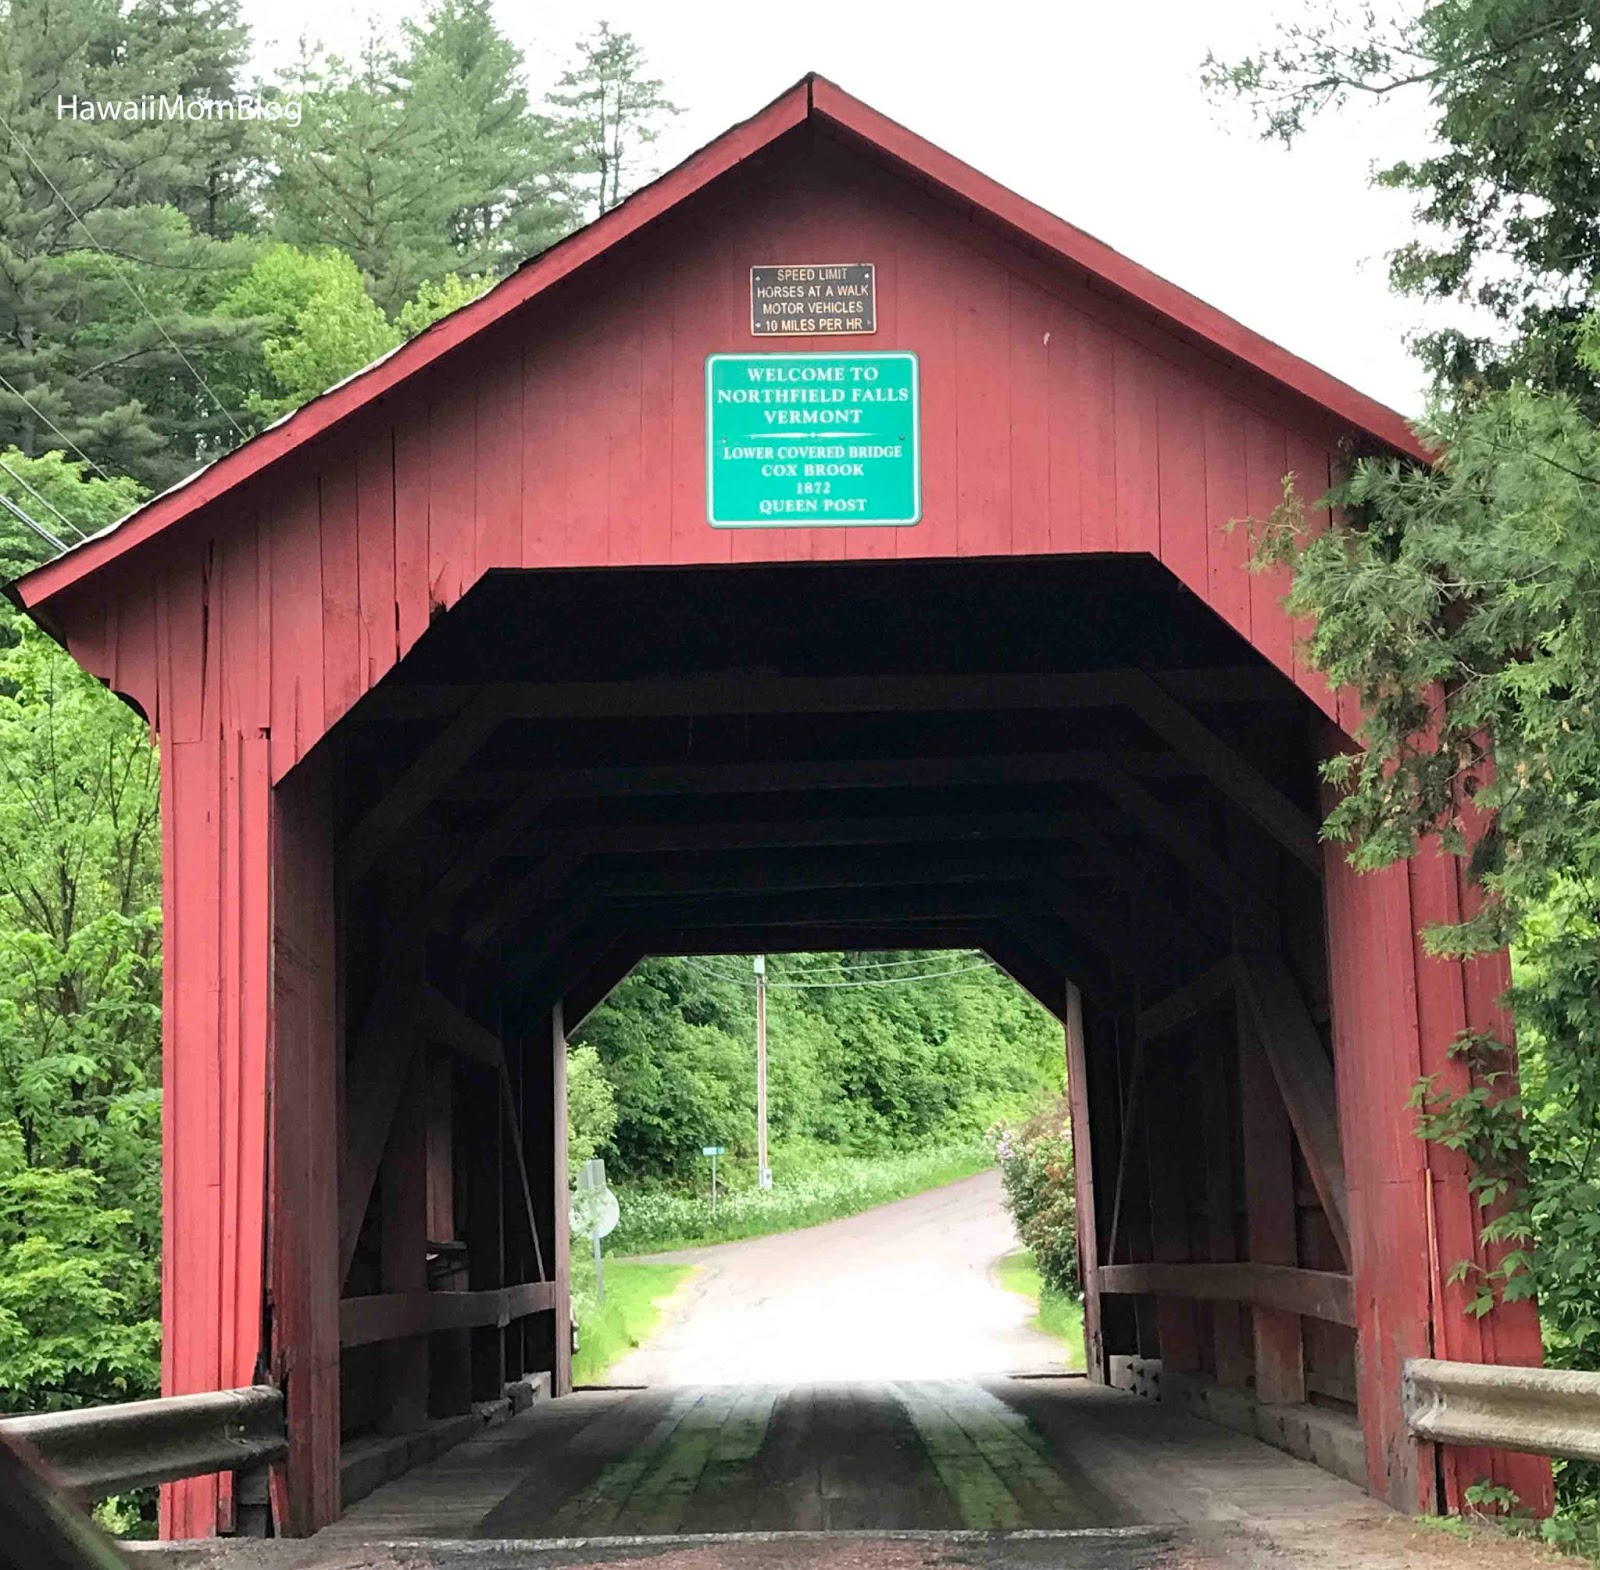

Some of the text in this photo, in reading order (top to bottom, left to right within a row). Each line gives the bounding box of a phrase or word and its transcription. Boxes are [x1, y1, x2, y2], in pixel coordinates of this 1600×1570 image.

[777, 268, 848, 282] SPEED LIMIT
[757, 284, 869, 298] HORSES AT A WALK
[763, 301, 864, 314] MOTOR VEHICLES
[765, 318, 863, 332] 10 MILES PER HR
[747, 367, 879, 382] WELCOME TO
[717, 388, 909, 404] NORTHFIELD FALLS
[764, 409, 863, 424] VERMONT
[723, 446, 902, 460] LOWER COVERED BRIDGE
[761, 464, 864, 477] COX BROOK
[796, 482, 831, 494] 1872
[759, 499, 867, 514] QUEEN POST
